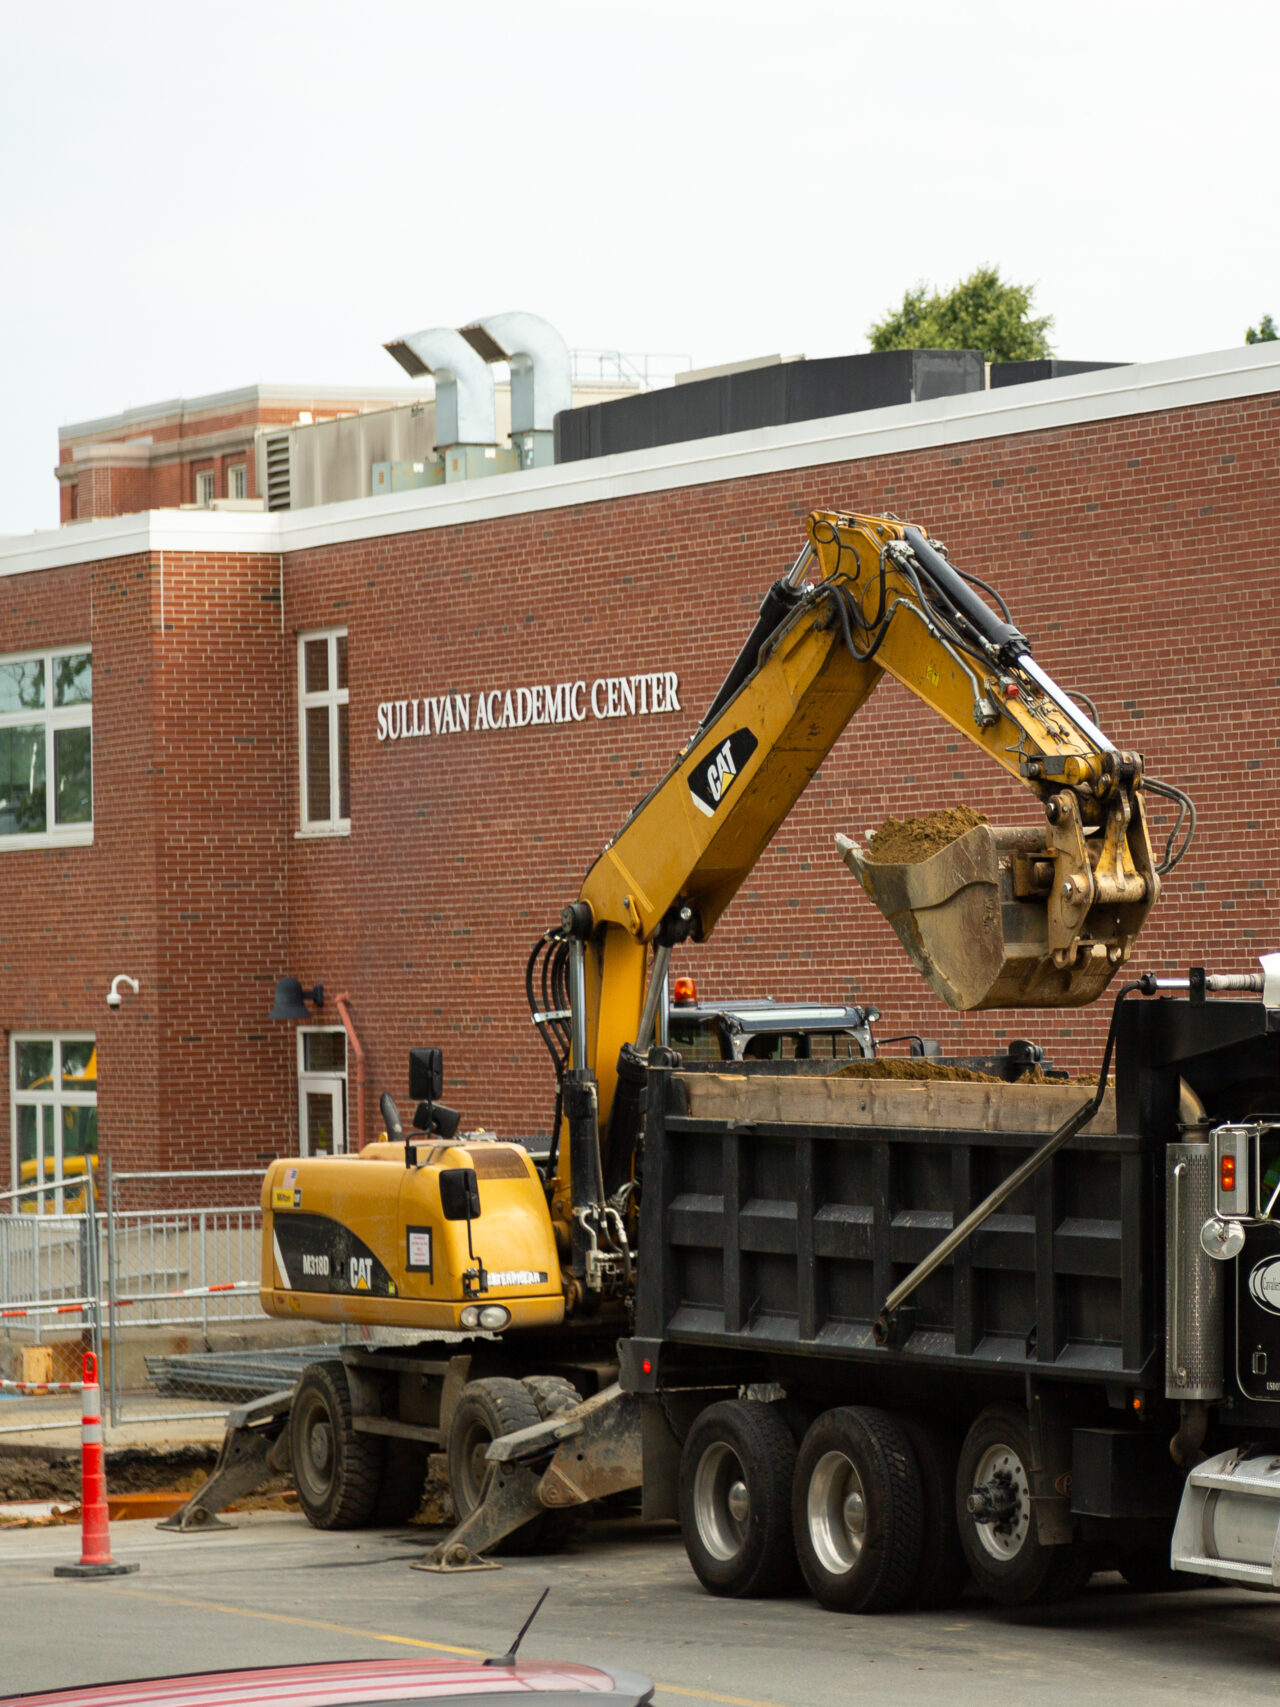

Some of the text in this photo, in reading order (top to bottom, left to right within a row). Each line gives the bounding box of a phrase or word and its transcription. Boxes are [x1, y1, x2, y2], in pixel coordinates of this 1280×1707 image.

[376, 671, 681, 741] SULLIVAN ACADEMIC CENTER
[707, 739, 737, 802] CAT
[302, 1254, 330, 1276] M318D
[349, 1256, 373, 1290] CAT
